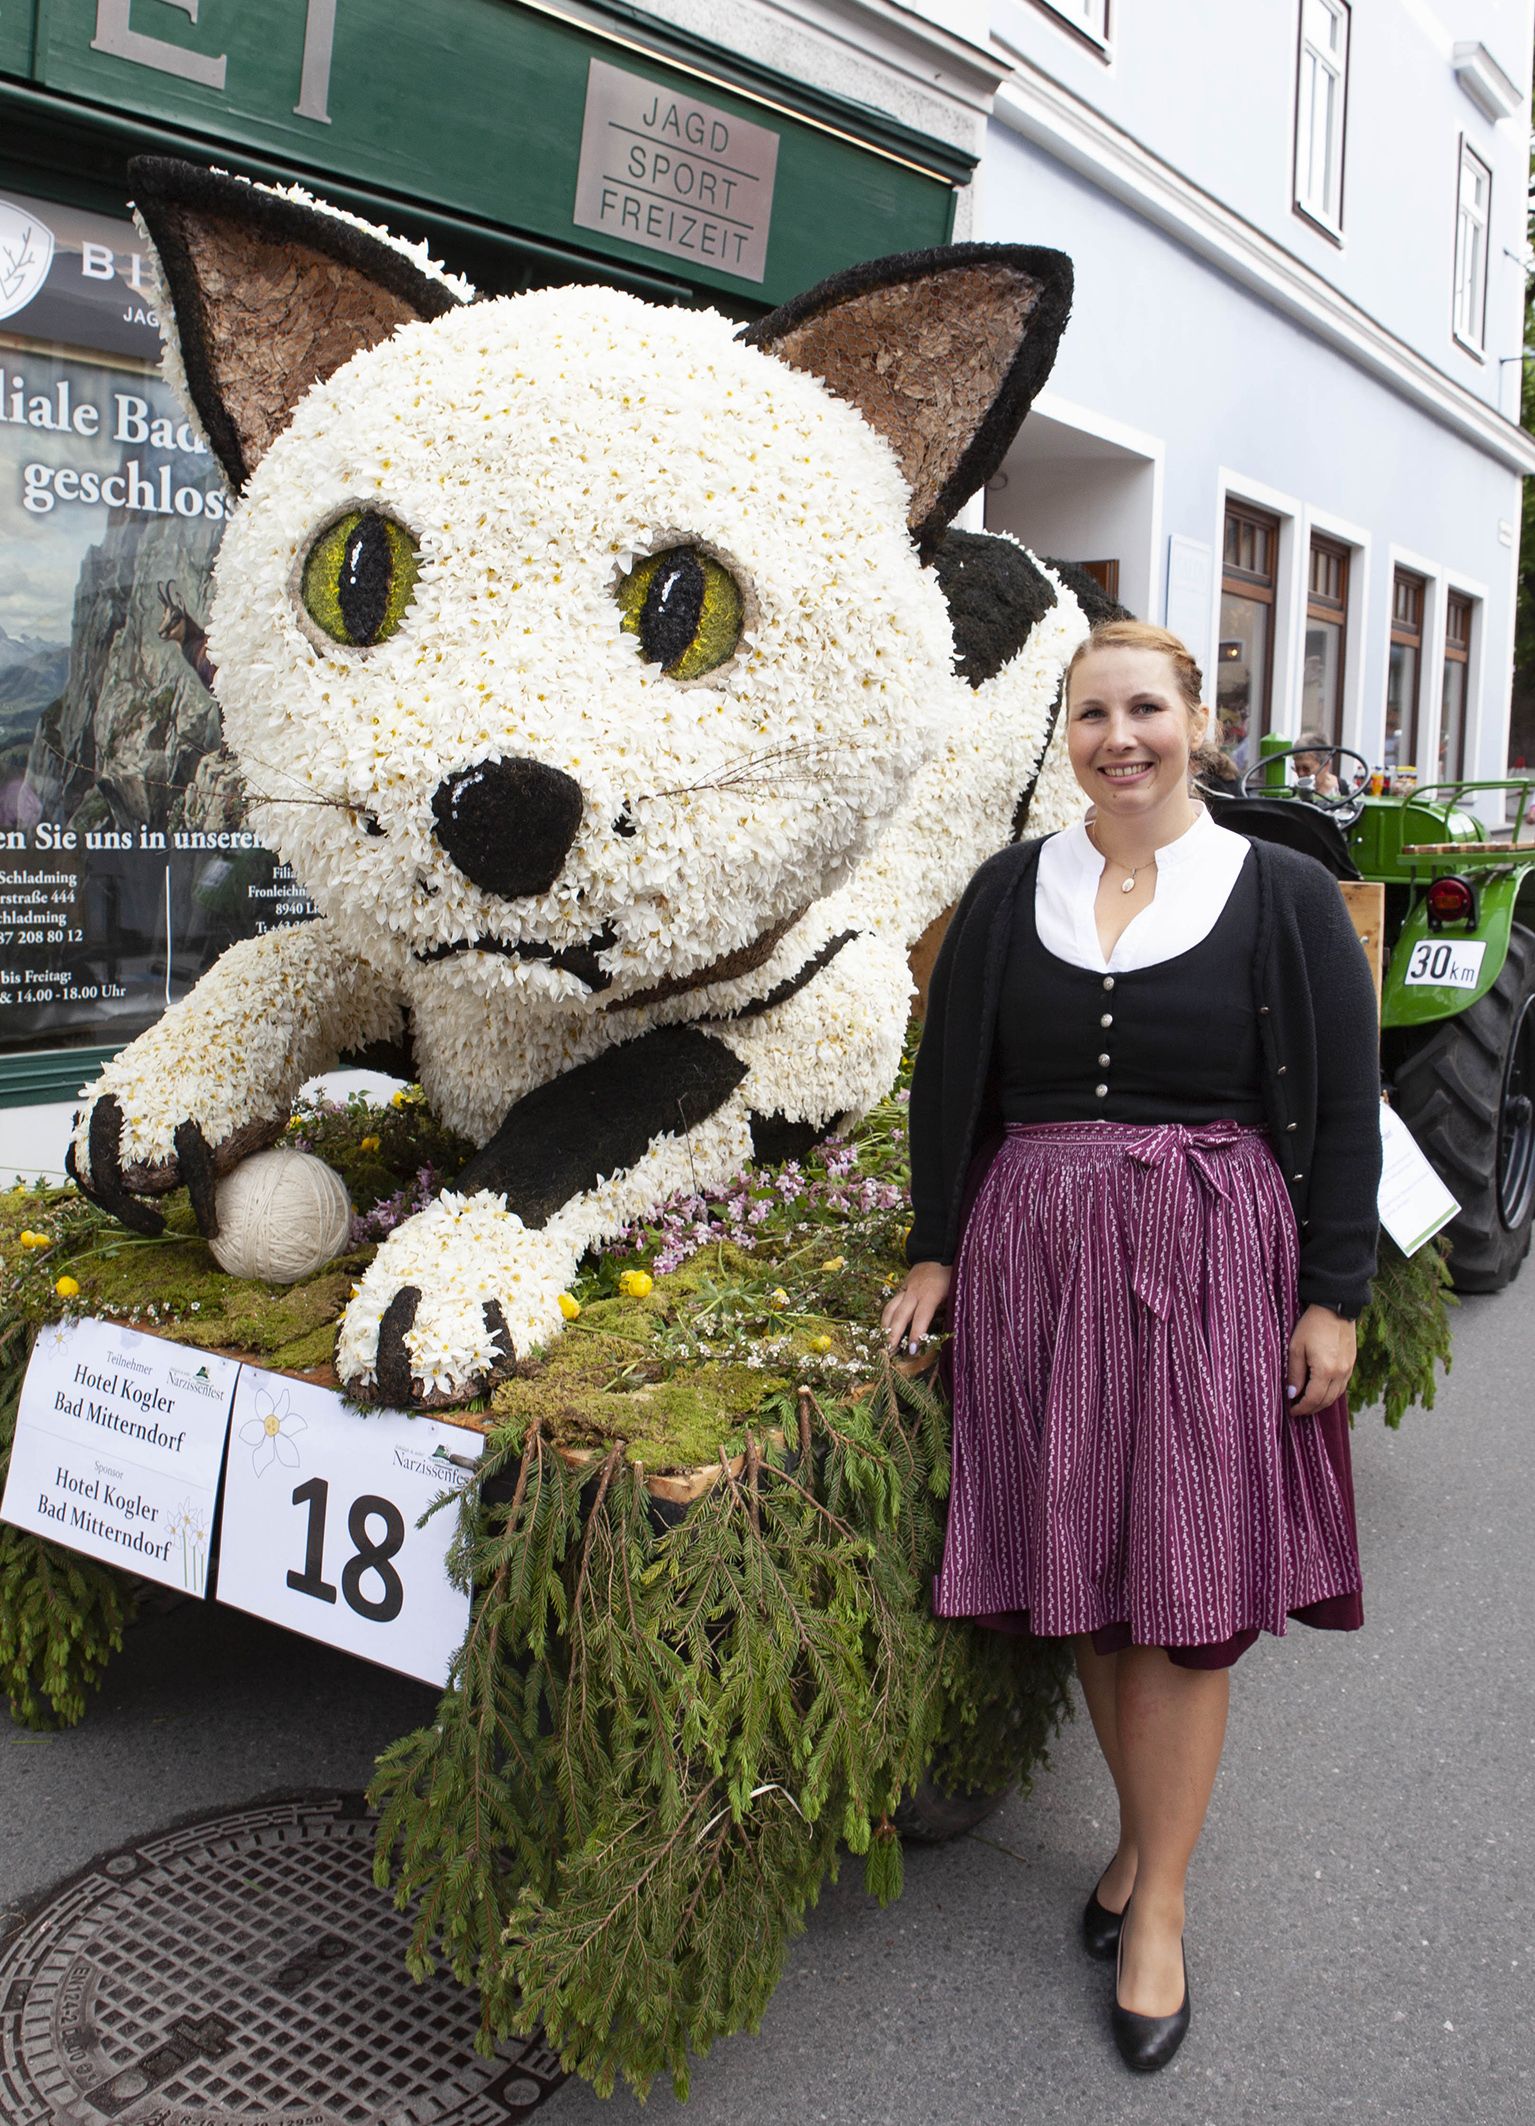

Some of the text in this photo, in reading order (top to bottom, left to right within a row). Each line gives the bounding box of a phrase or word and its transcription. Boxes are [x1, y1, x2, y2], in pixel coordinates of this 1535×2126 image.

[642, 97, 729, 153] JAGD
[628, 146, 738, 209] SPORT
[600, 189, 749, 263] FREIZEIT
[35, 823, 77, 850] Sie
[85, 830, 133, 850] uns
[140, 824, 167, 849] in
[0, 870, 77, 888] Schladming
[50, 889, 75, 903] 444
[275, 902, 304, 915] 8940
[18, 931, 44, 944] 208
[47, 930, 64, 943] 80
[68, 929, 83, 942] 12
[0, 969, 72, 985] bis Freitag:
[0, 991, 12, 1003] &
[17, 989, 53, 1003] 14.00
[101, 984, 126, 997] Uhr
[107, 1351, 153, 1376] Teilnehmer
[73, 1363, 176, 1413] Hotel Kogler
[166, 1369, 224, 1401] Narzissenfest
[54, 1391, 186, 1453] Bad Mitterndorf
[94, 1460, 124, 1480] Sponsor
[55, 1466, 159, 1522] Hotel Kogler
[37, 1493, 173, 1562] Bad Mitterndorf
[286, 1477, 405, 1623] 18
